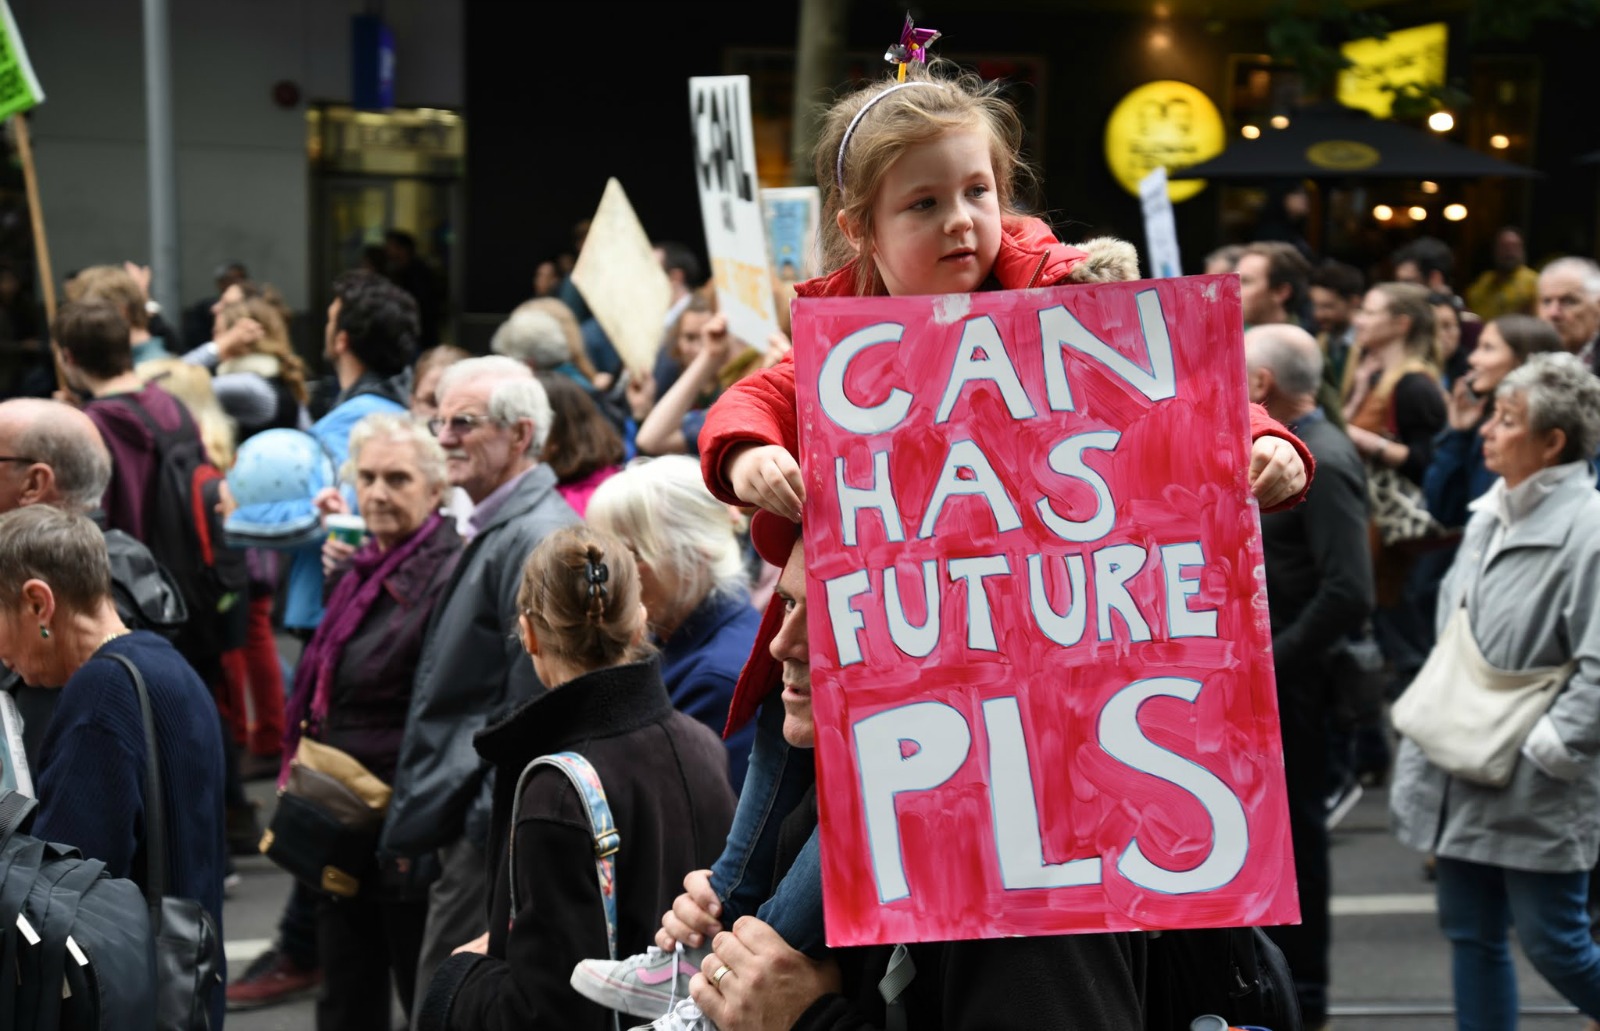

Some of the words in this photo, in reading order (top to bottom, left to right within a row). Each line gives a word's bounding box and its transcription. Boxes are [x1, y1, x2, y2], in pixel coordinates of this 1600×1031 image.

[817, 289, 1178, 437] CAN
[834, 429, 1122, 548] HAS
[825, 541, 1219, 667] FUTURE
[852, 677, 1250, 906] PLS
